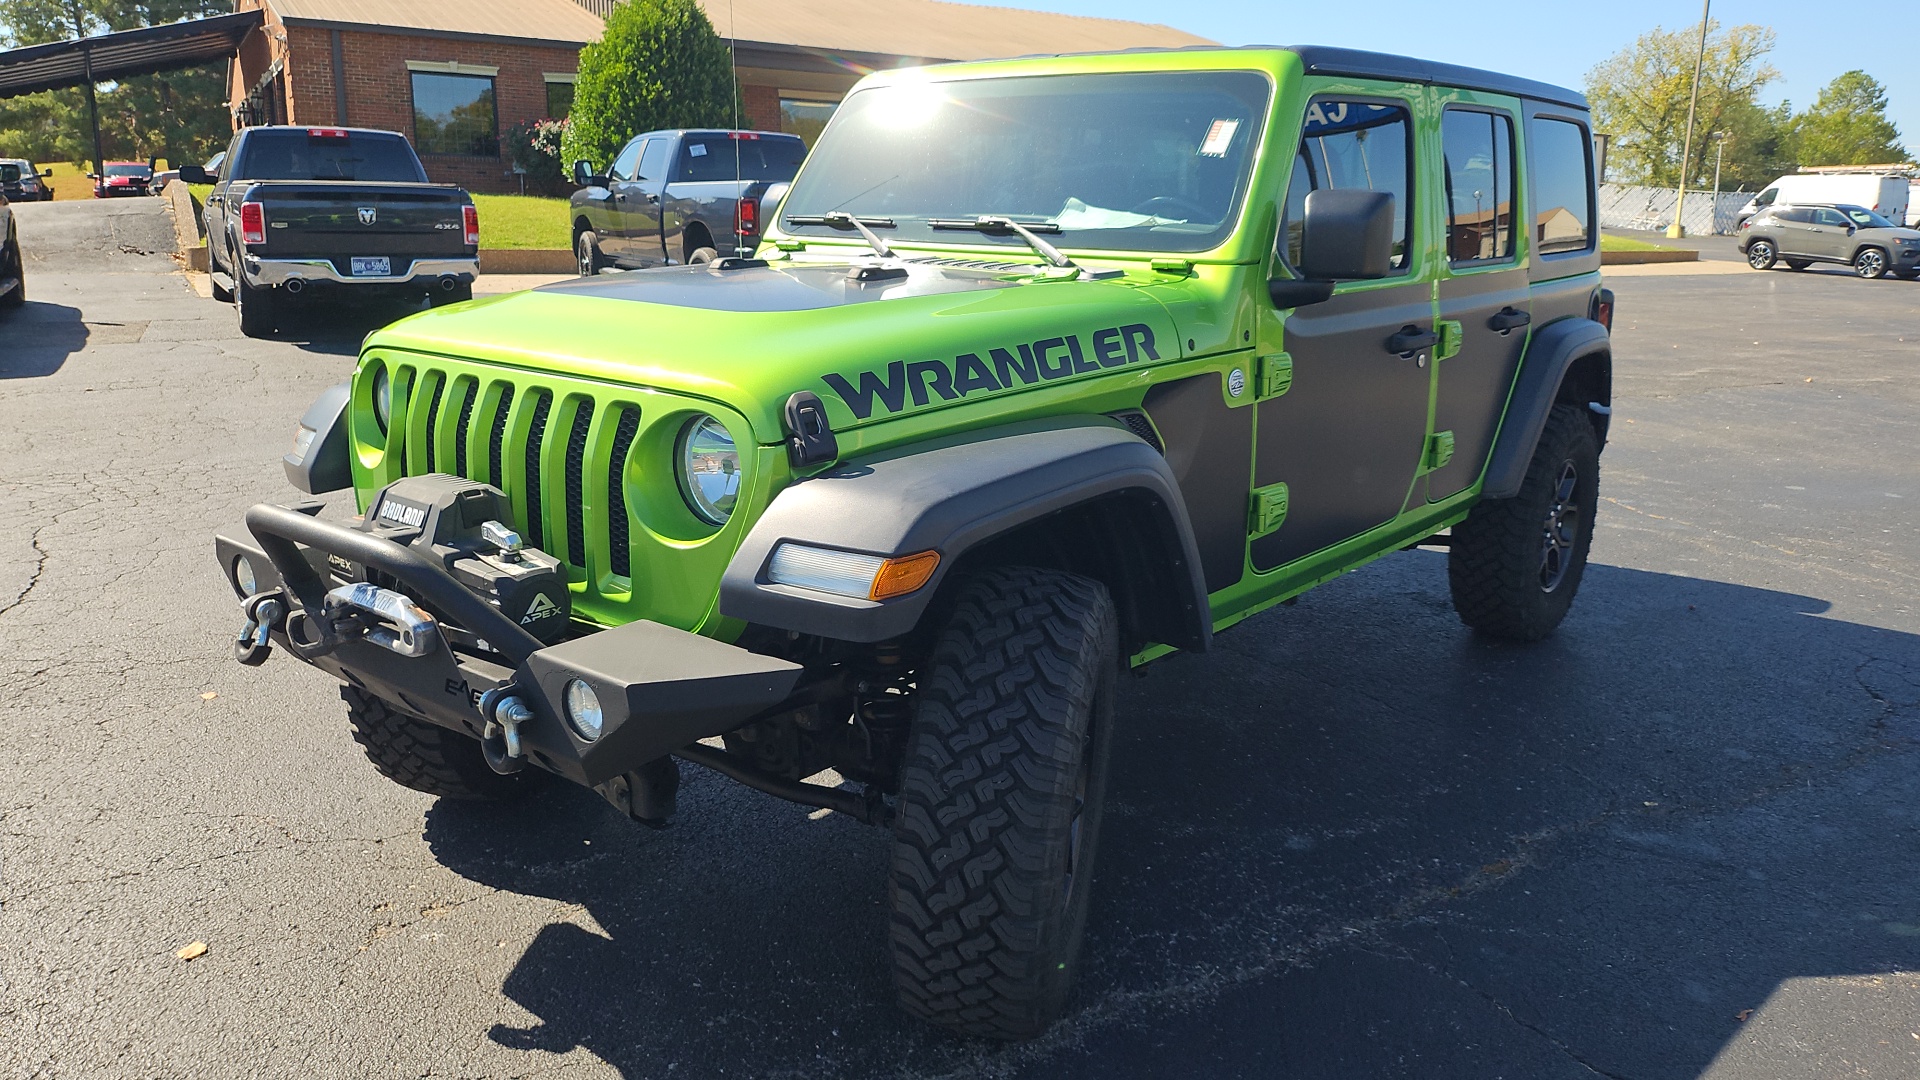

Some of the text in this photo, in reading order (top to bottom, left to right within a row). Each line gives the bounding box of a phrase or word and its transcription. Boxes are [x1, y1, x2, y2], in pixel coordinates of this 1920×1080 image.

[820, 323, 1160, 419] WRANGLER
[381, 500, 425, 527] BADLAND
[328, 553, 352, 571] APEX
[520, 606, 562, 625] APEX
